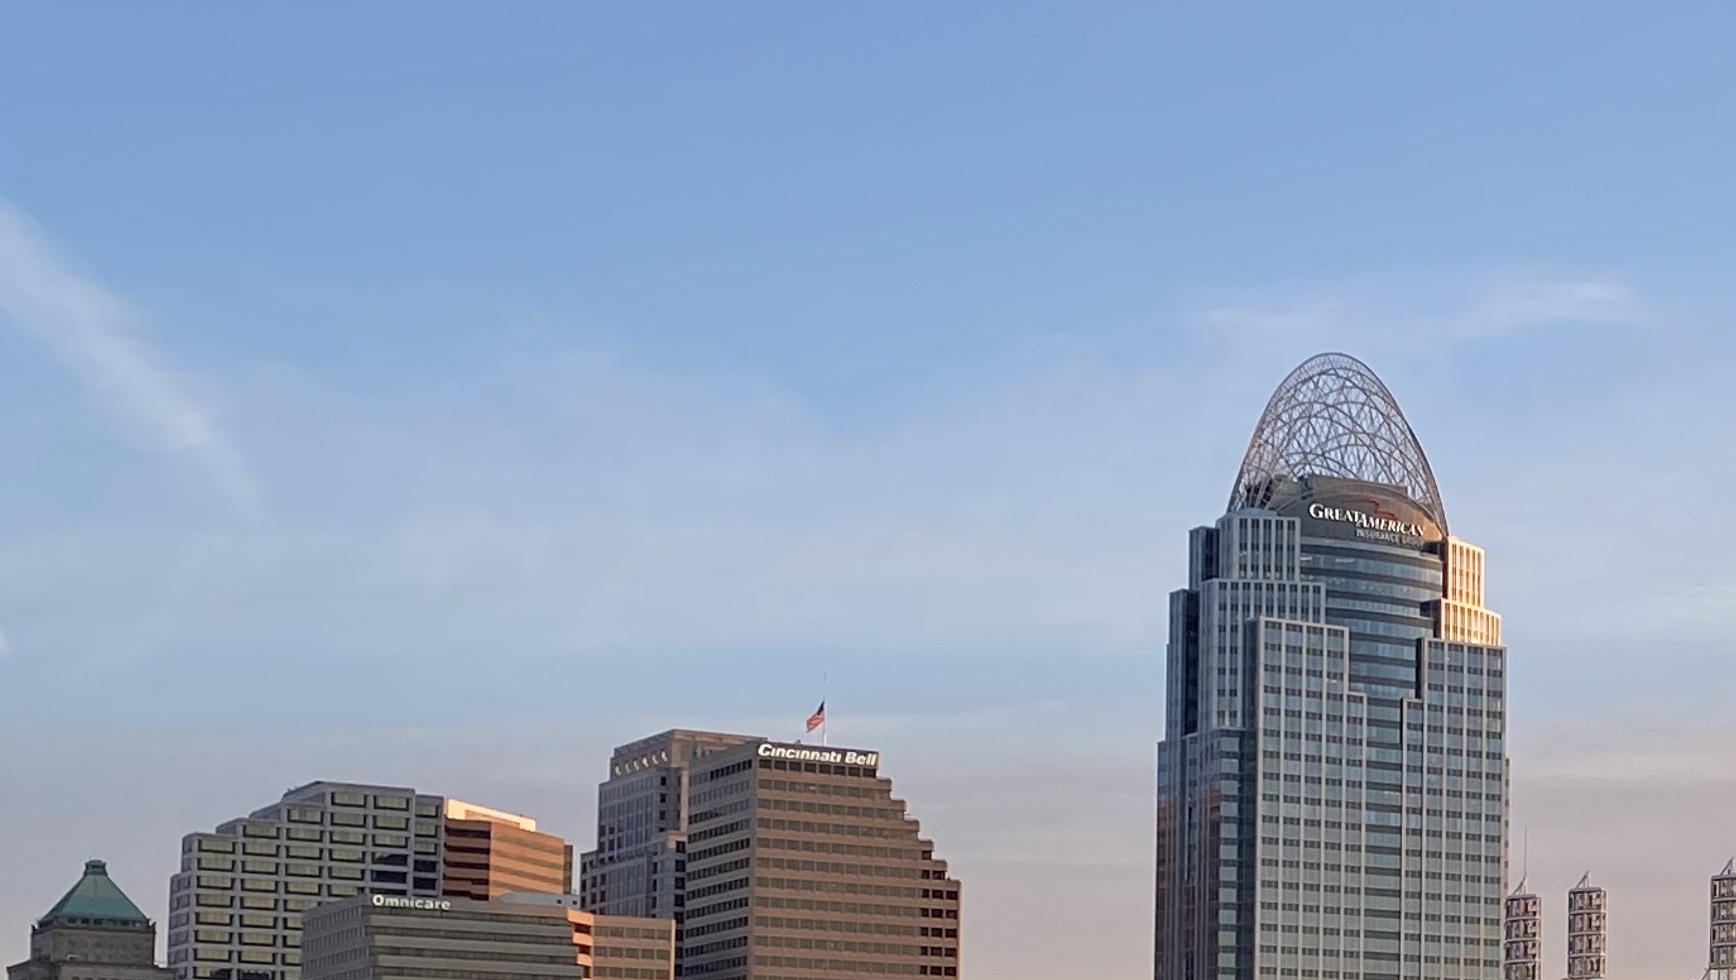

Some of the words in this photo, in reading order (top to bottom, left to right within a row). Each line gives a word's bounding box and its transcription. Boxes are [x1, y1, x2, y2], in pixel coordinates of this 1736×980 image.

[758, 743, 841, 763] Cincinnati
[845, 751, 879, 766] Bell
[372, 894, 451, 911] Omnicare
